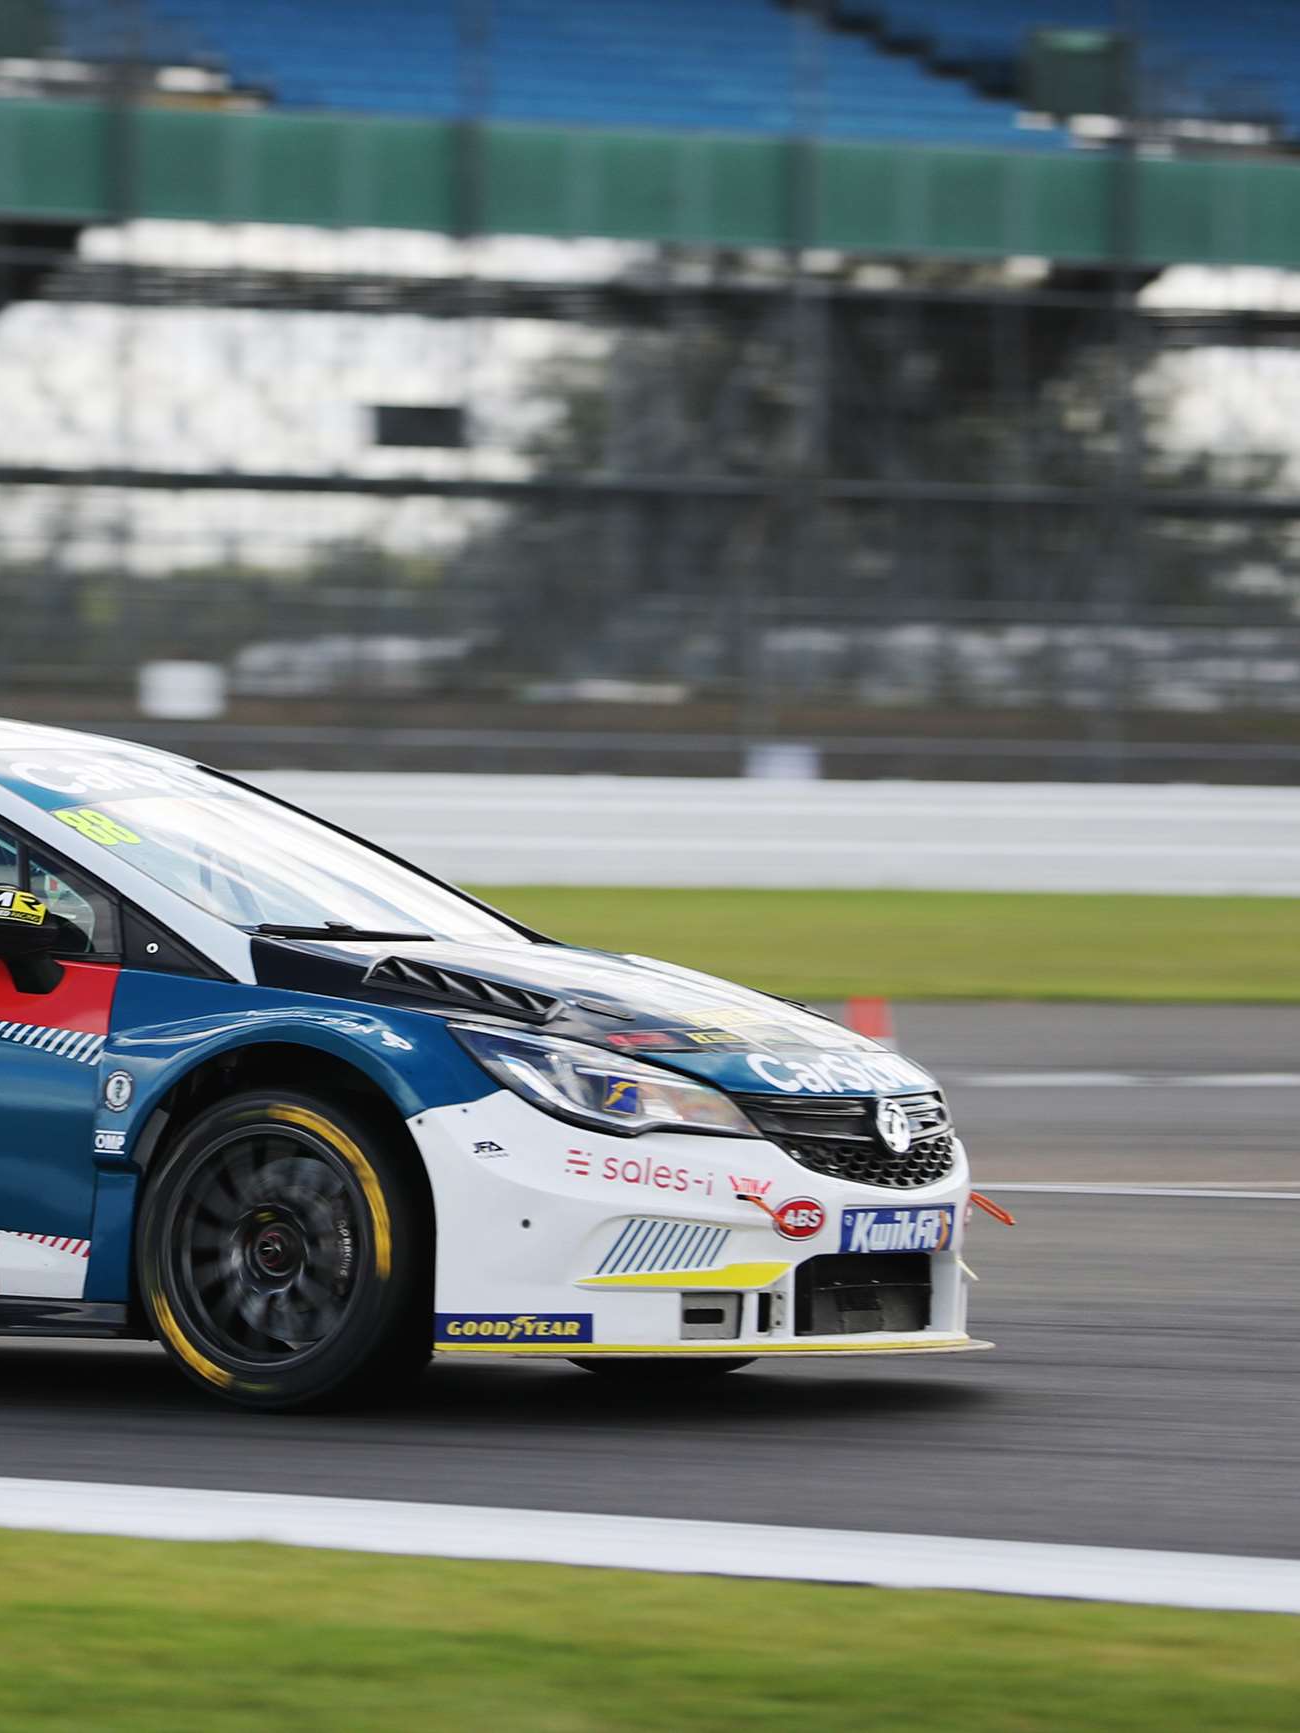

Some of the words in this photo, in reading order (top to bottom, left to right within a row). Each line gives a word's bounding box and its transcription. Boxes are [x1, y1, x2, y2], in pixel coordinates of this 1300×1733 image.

[53, 807, 142, 846] 88
[602, 1156, 714, 1196] sales-i
[784, 1208, 823, 1229] ABS
[446, 1318, 581, 1338] GOODYEAR
